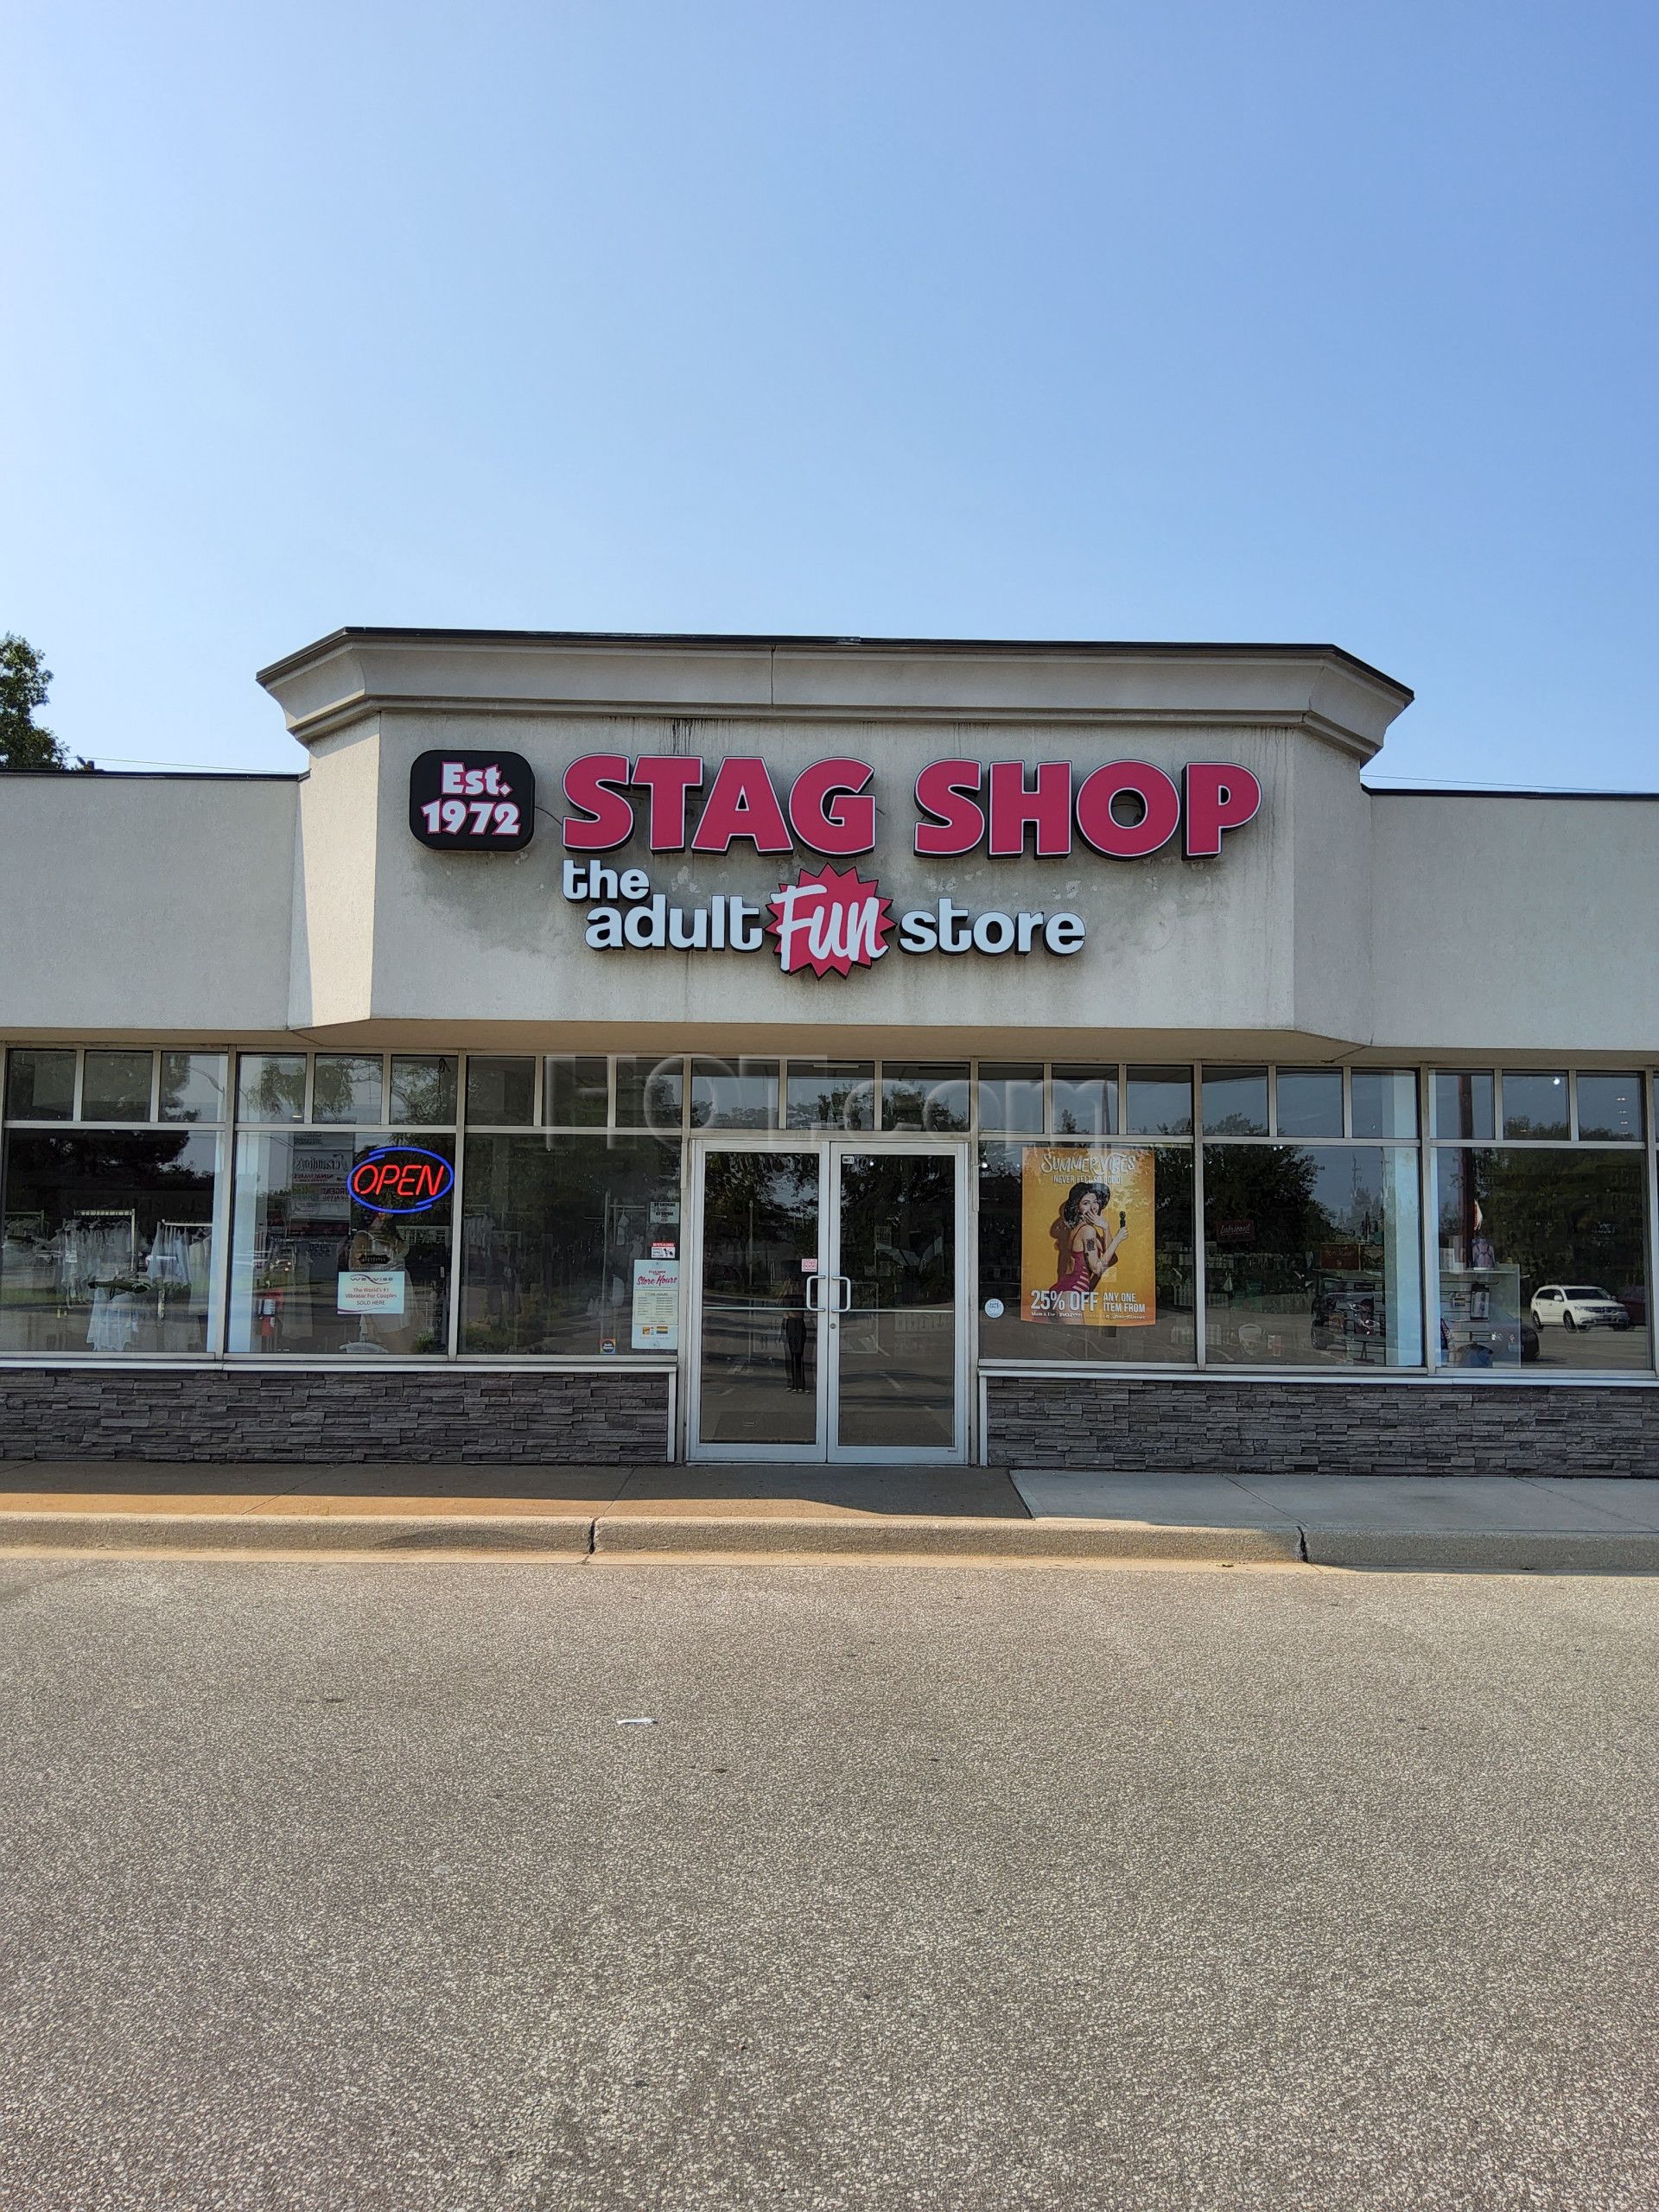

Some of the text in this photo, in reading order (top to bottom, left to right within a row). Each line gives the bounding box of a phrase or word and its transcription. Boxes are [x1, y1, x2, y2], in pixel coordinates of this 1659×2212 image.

[441, 761, 512, 797] Est.
[420, 798, 521, 836] 1972
[562, 753, 1262, 861] STAG SHOP
[562, 858, 651, 902] the
[584, 883, 1087, 974] adult Fun store
[353, 1164, 445, 1197] OPEN
[1052, 1175, 1075, 1184] NEVER
[1092, 1175, 1103, 1184] SO
[636, 1274, 678, 1287] Store Hours
[1103, 1292, 1136, 1302] ANY ONE
[1030, 1290, 1099, 1312] 25% OFF
[1103, 1302, 1146, 1313] ITEM FROM
